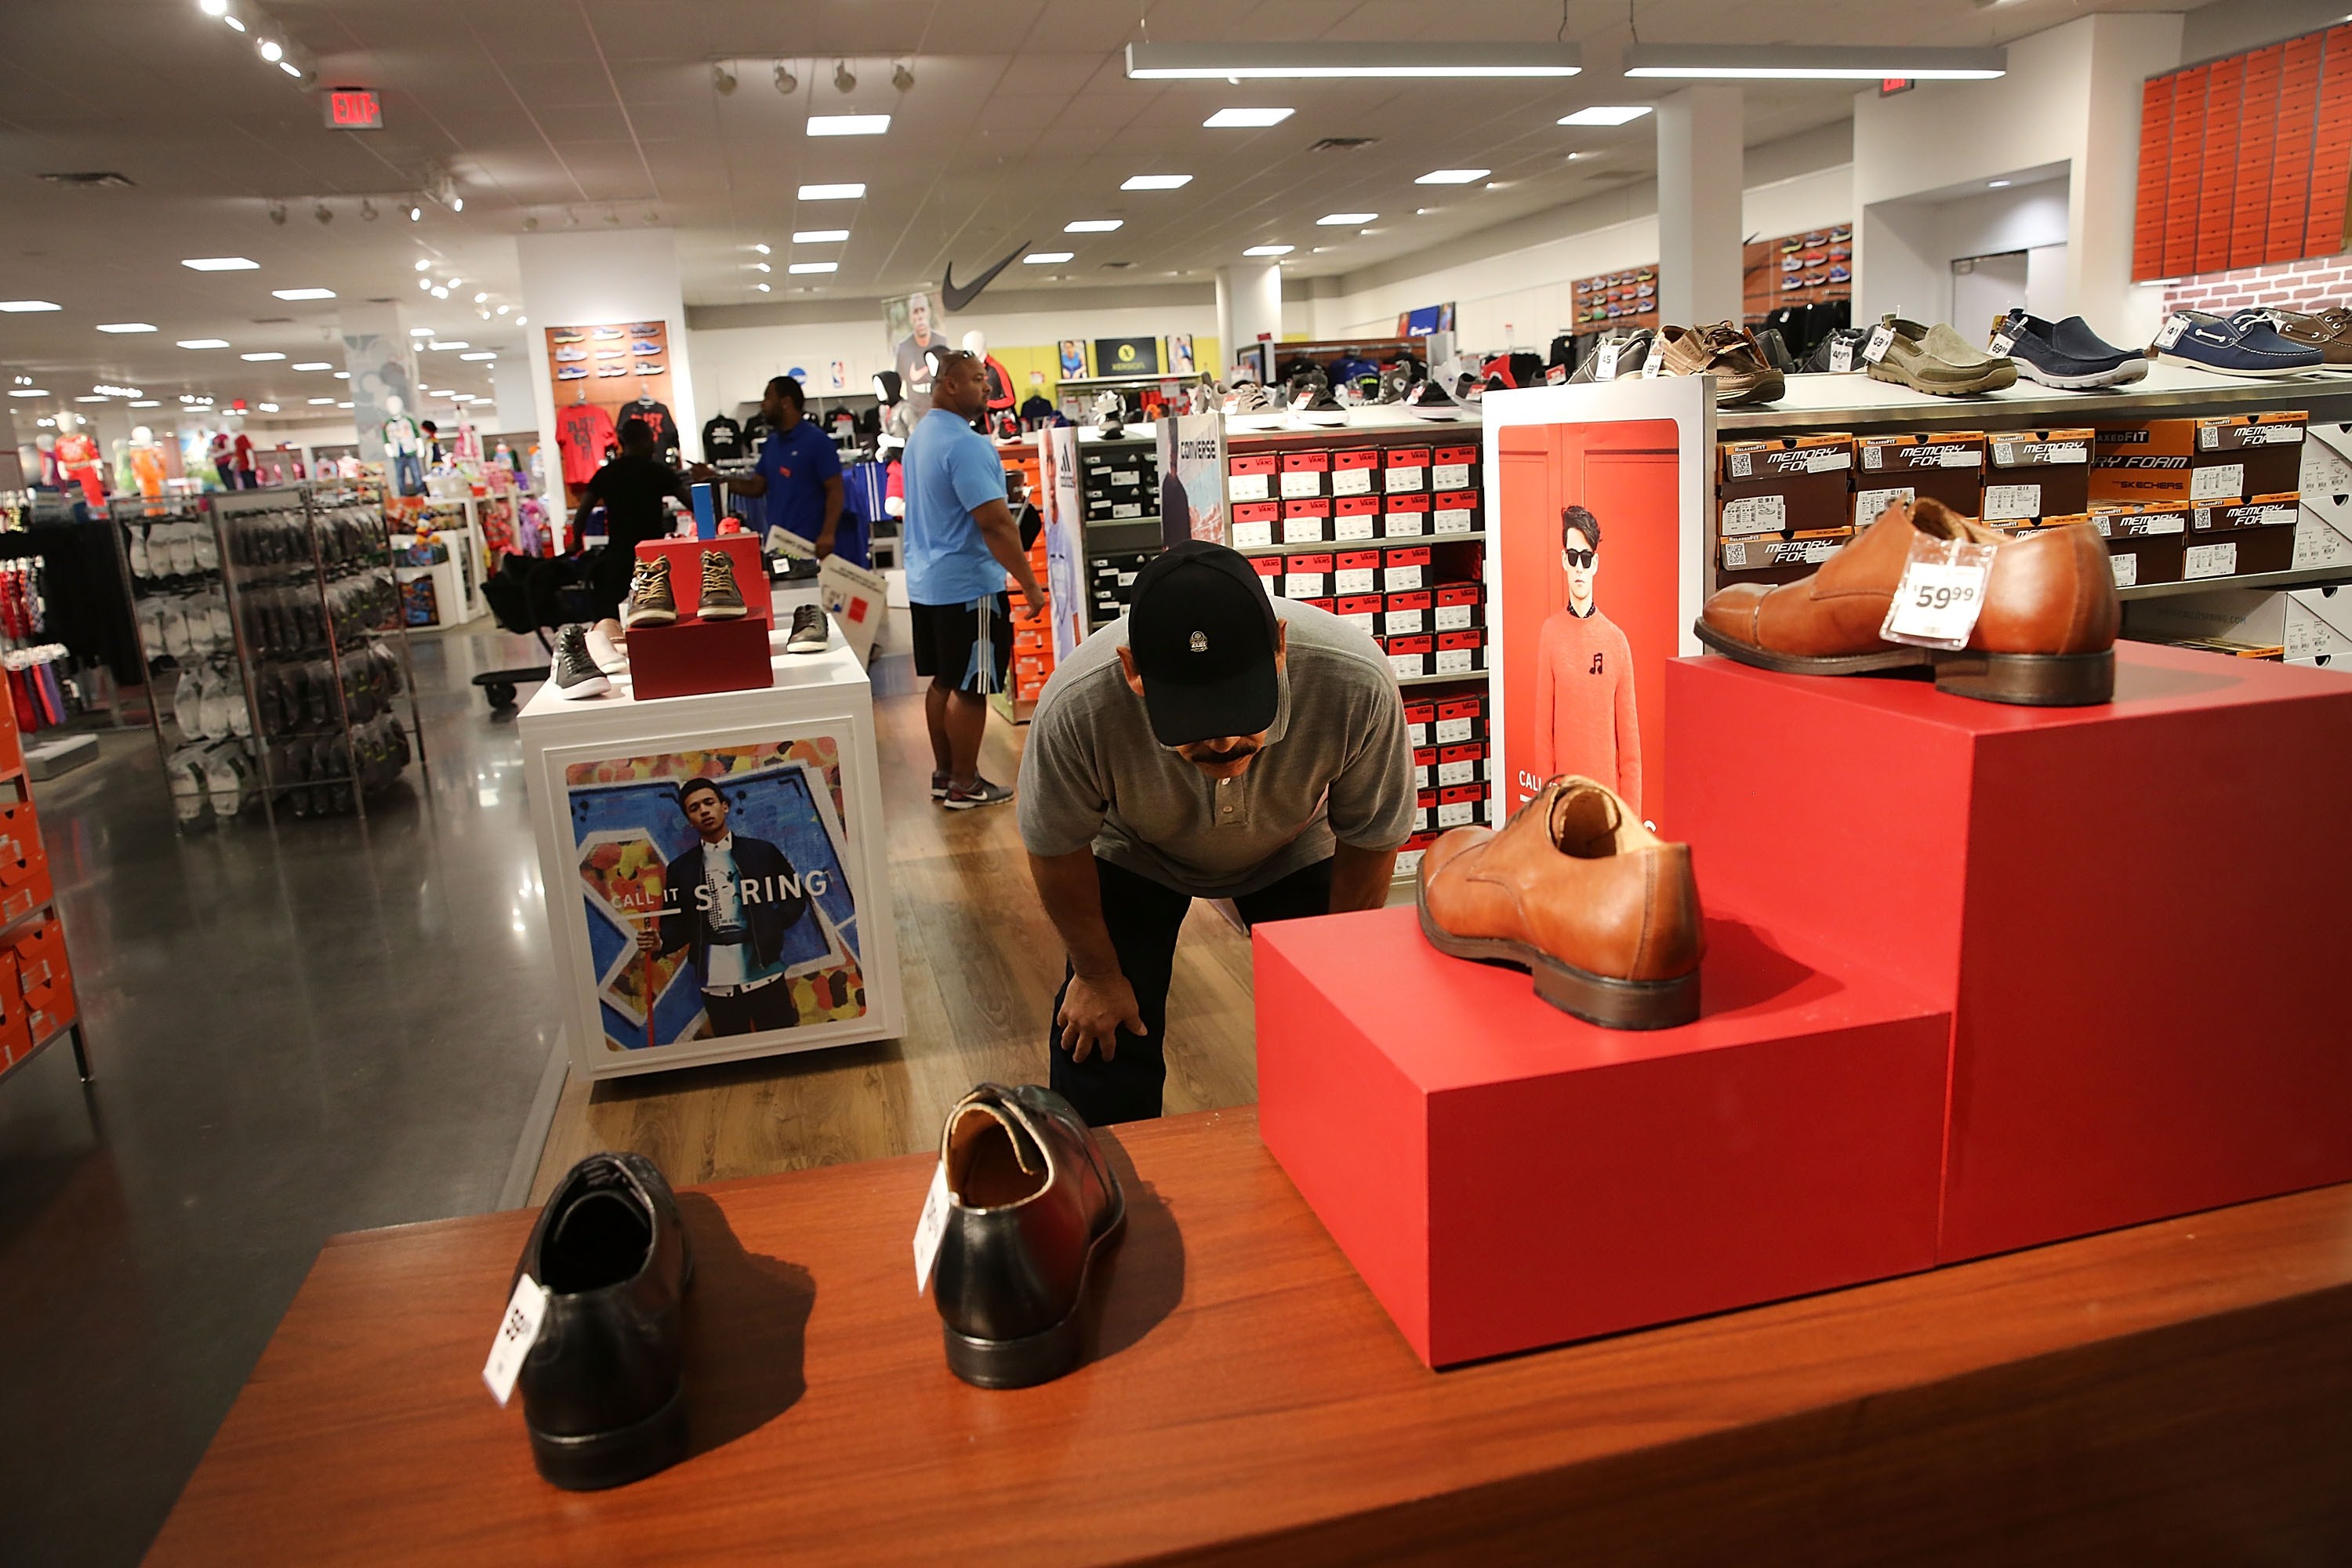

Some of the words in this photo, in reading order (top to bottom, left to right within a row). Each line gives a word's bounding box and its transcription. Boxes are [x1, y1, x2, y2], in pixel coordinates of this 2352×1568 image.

[332, 93, 372, 124] EXIT
[2234, 424, 2292, 437] MEMORY
[2096, 431, 2147, 443] AXEDFIT
[2242, 435, 2267, 445] FOA
[1181, 440, 1215, 460] CONVERSE
[1900, 444, 1965, 458] MEMORY
[2023, 441, 2085, 454] MEMORY
[1767, 447, 1838, 464] MEMORY
[2125, 457, 2187, 469] FOAM
[2121, 481, 2183, 490] SKECHERS
[2227, 505, 2285, 517] MEMORY
[2120, 514, 2179, 526] MEMORY
[1765, 540, 1833, 554] MEMORY
[1413, 593, 1428, 601] VANS
[1416, 706, 1432, 715] VANS
[611, 889, 654, 909] CALL
[664, 887, 679, 902] IT
